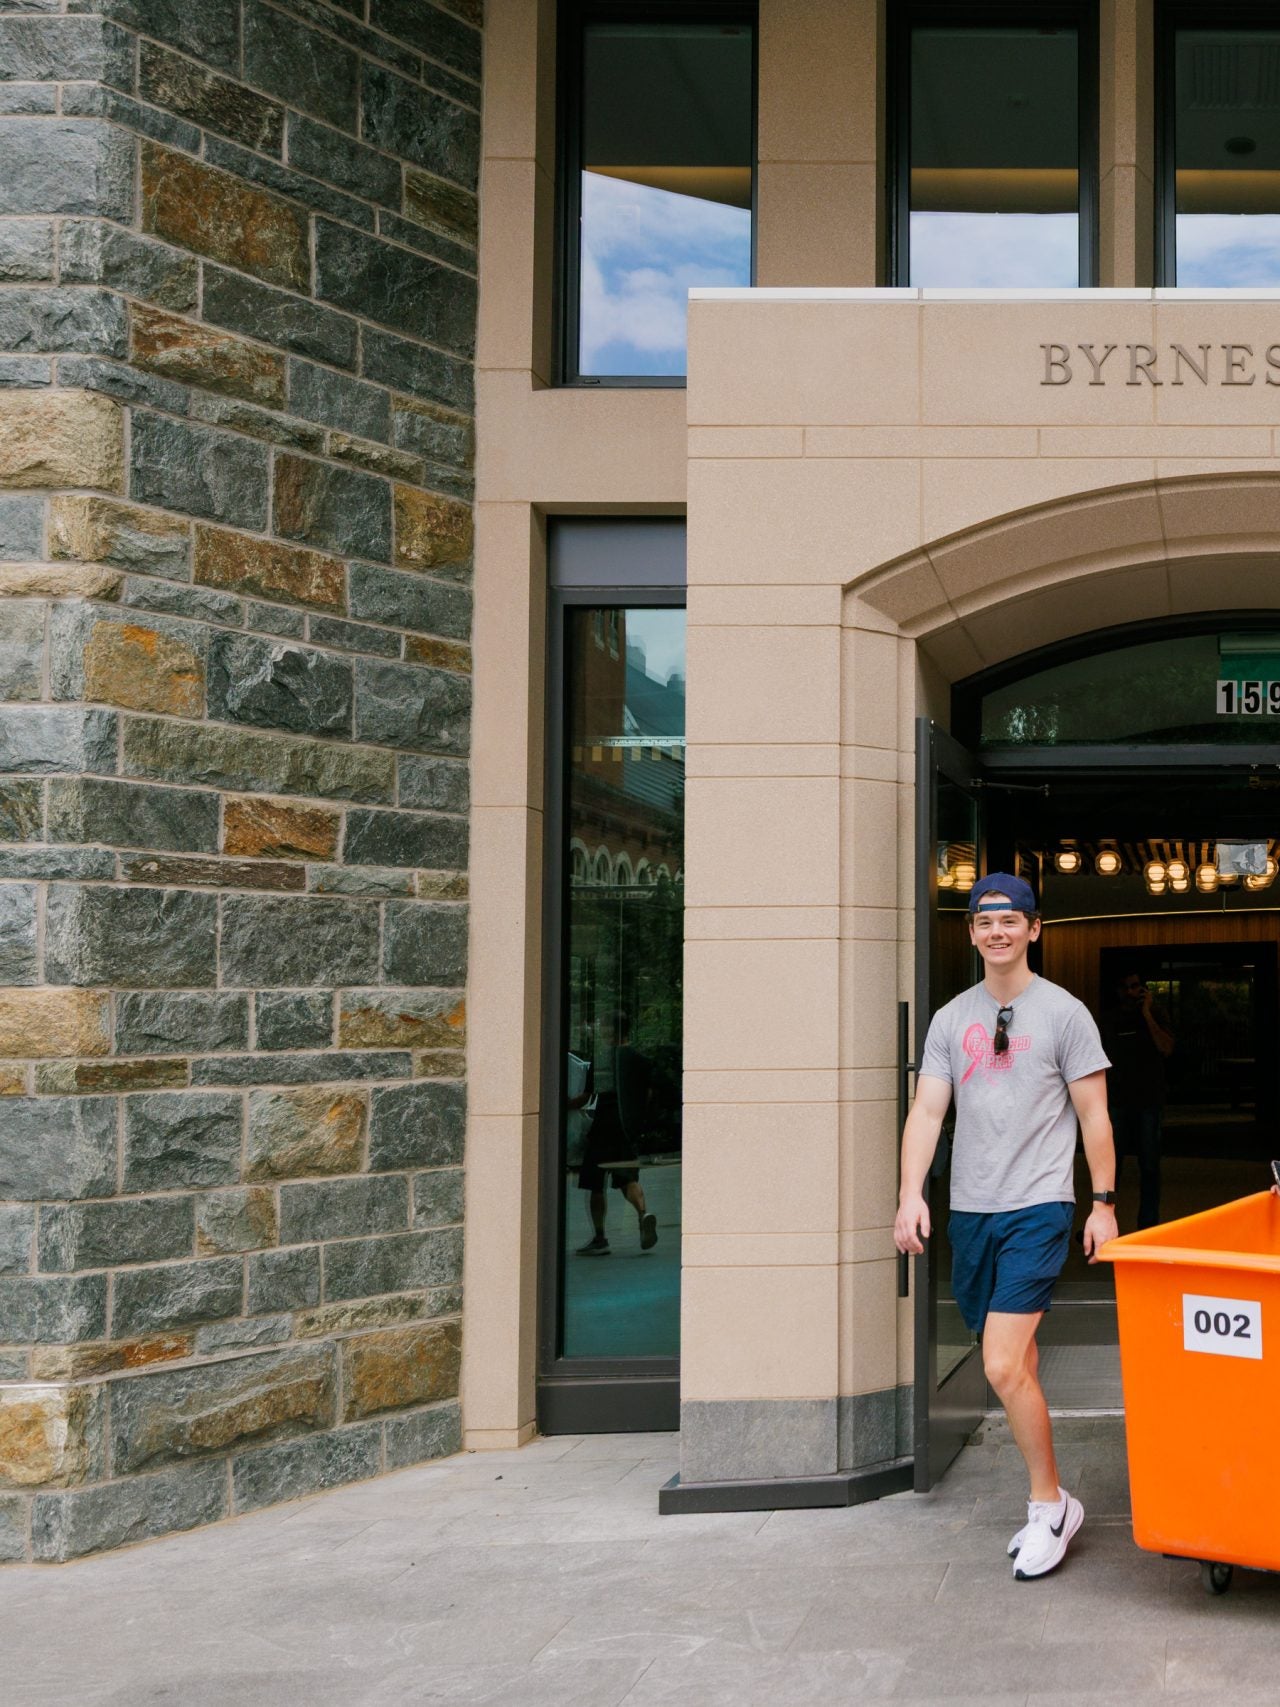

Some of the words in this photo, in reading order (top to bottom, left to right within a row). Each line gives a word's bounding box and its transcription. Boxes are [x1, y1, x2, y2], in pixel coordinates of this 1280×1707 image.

[971, 1036, 1032, 1053] FAIELD
[985, 1054, 1014, 1069] PREP
[1194, 1309, 1251, 1339] 002
